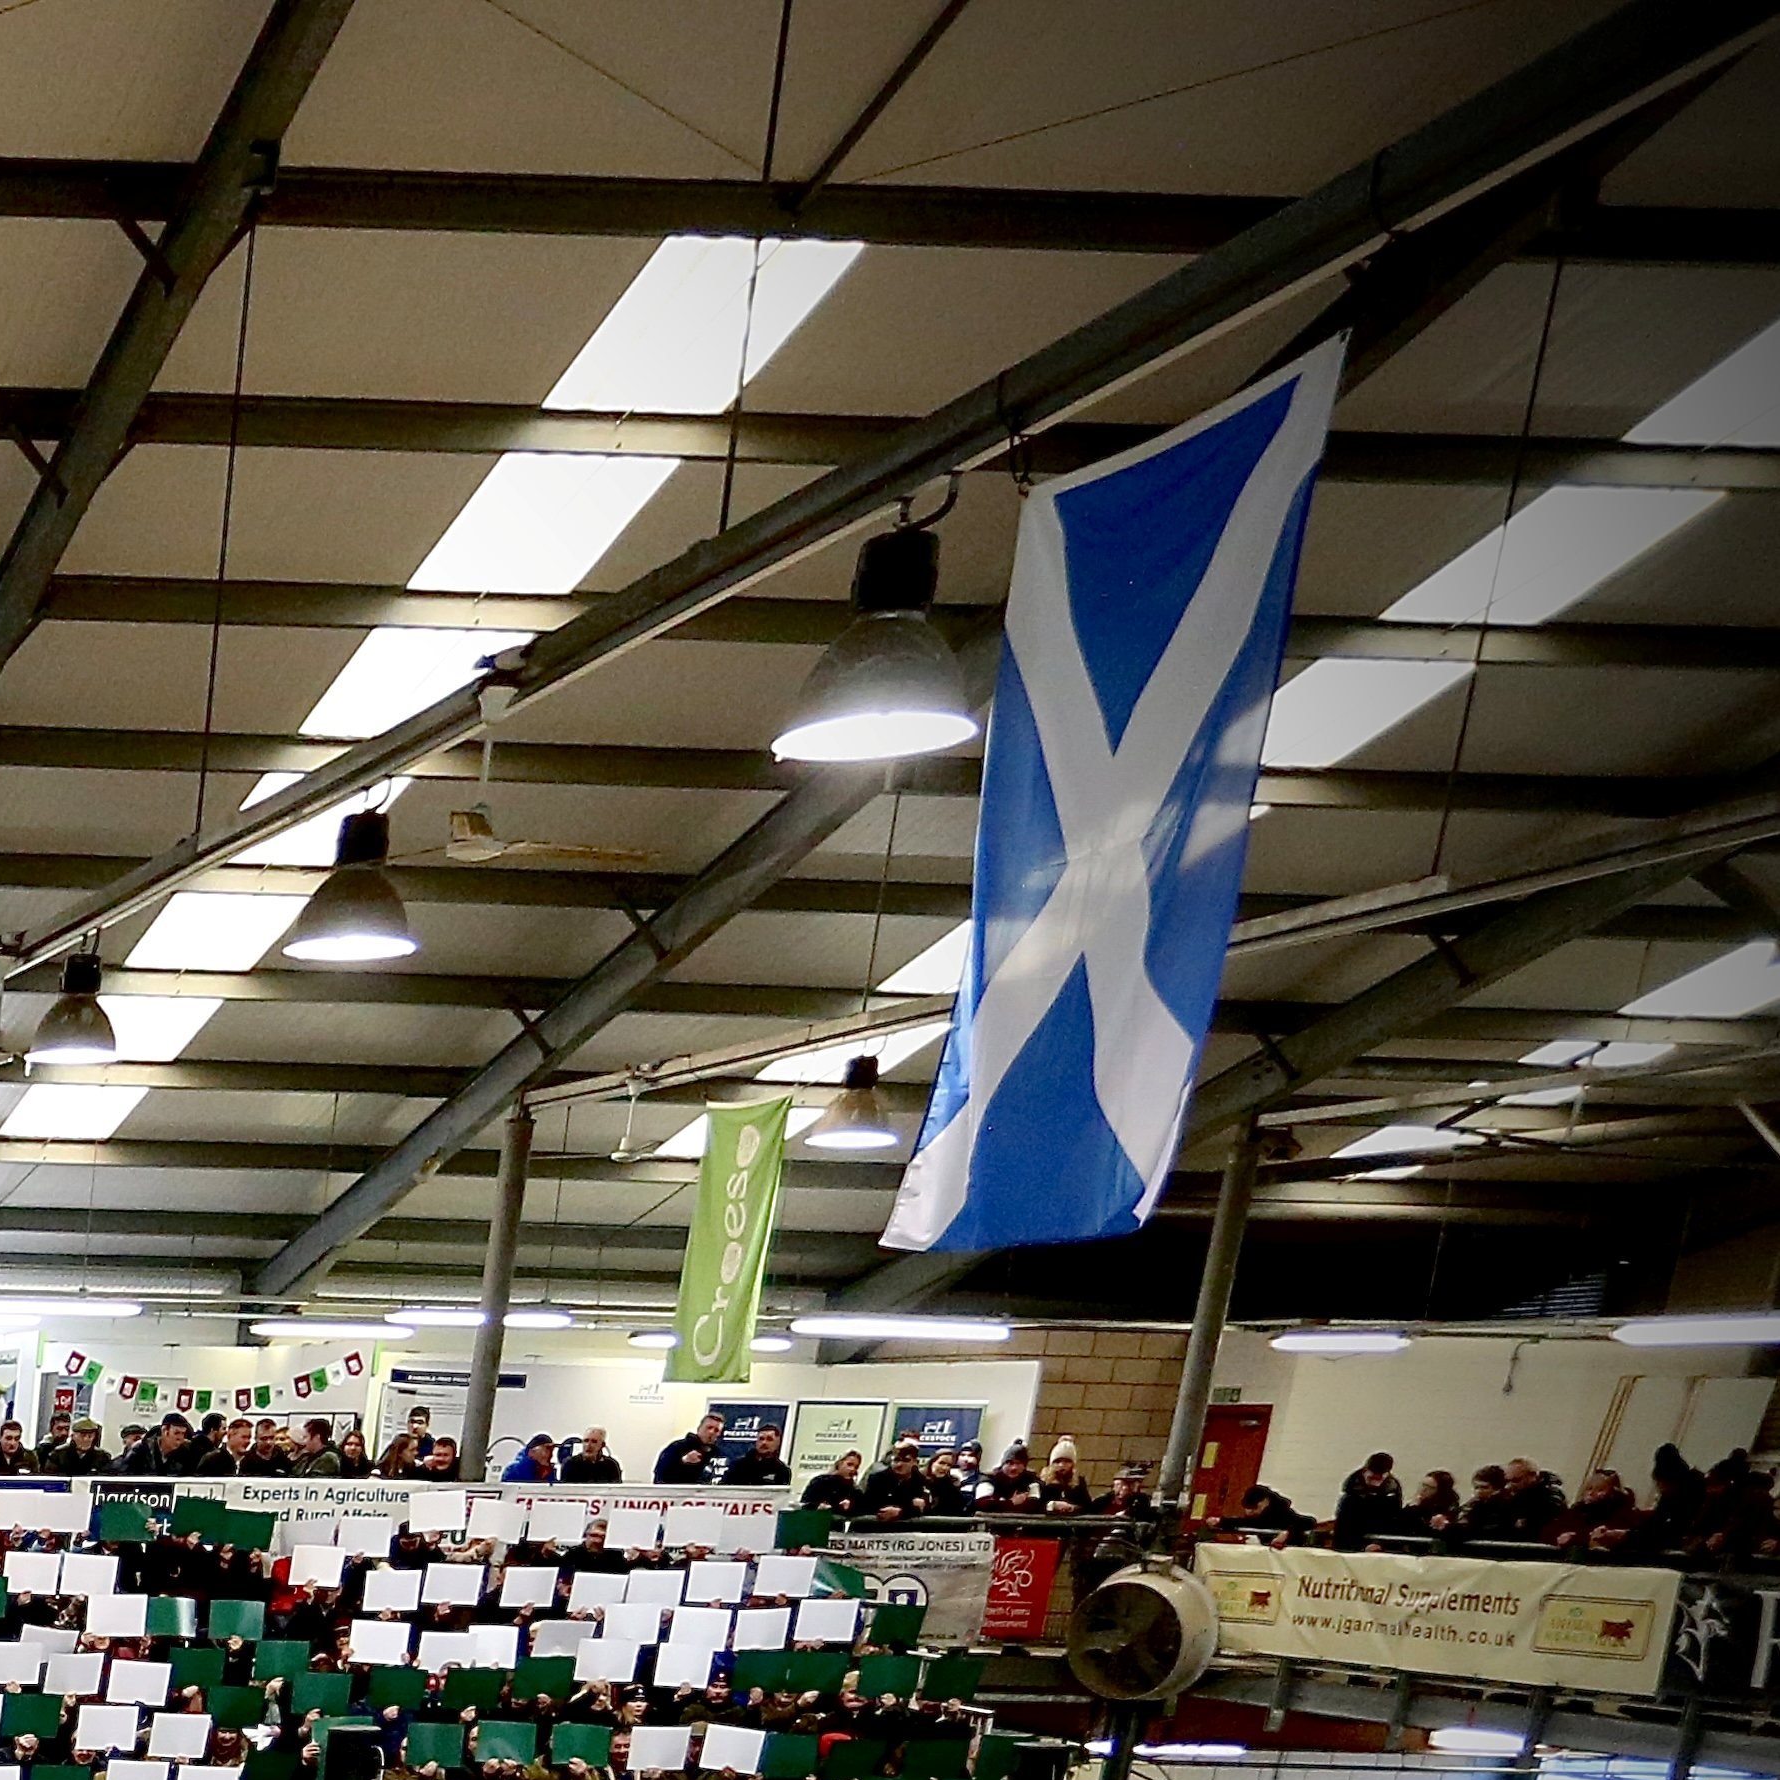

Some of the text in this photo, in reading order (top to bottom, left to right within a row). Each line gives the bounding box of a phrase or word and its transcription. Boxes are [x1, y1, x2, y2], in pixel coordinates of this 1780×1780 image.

[692, 1124, 762, 1368] Croeso
[242, 1486, 300, 1503] Experts
[305, 1486, 319, 1500] in
[324, 1487, 410, 1504] Agriculture
[848, 1539, 990, 1552] MARTS (RG JONES) LTD
